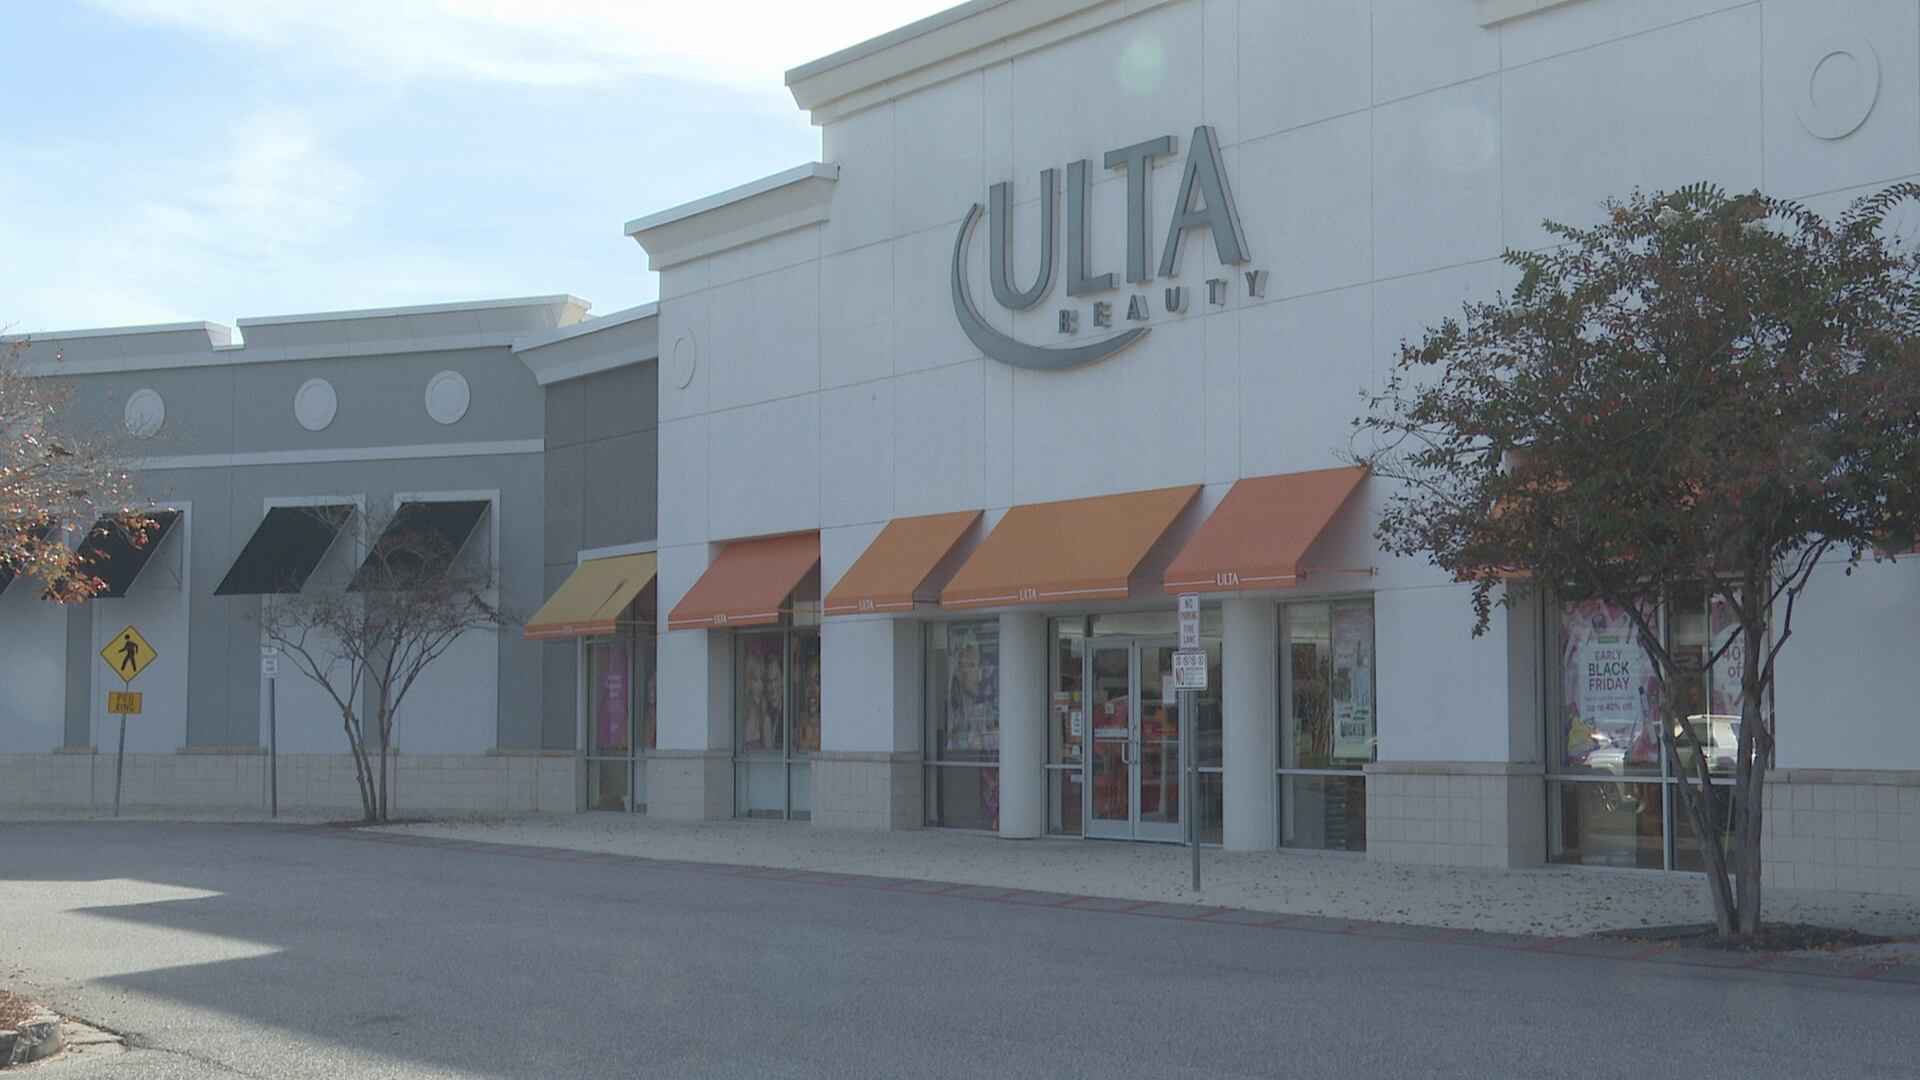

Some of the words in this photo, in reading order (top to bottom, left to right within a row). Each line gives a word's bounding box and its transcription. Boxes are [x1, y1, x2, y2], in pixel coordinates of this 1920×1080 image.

[988, 125, 1250, 311] ULTA
[1058, 269, 1269, 334] BEAUTY
[1217, 572, 1239, 586] ULTA
[1019, 588, 1037, 600] ULTA
[858, 600, 874, 610] ULTA
[1185, 599, 1193, 608] NO
[1595, 650, 1622, 661] EARLY
[1722, 646, 1745, 661] 40
[1589, 661, 1629, 677] BLACK
[1728, 661, 1744, 678] of
[1589, 677, 1630, 691] FRIDAY
[117, 693, 135, 702] PED
[116, 703, 135, 712] XING
[1606, 703, 1621, 711] 40%
